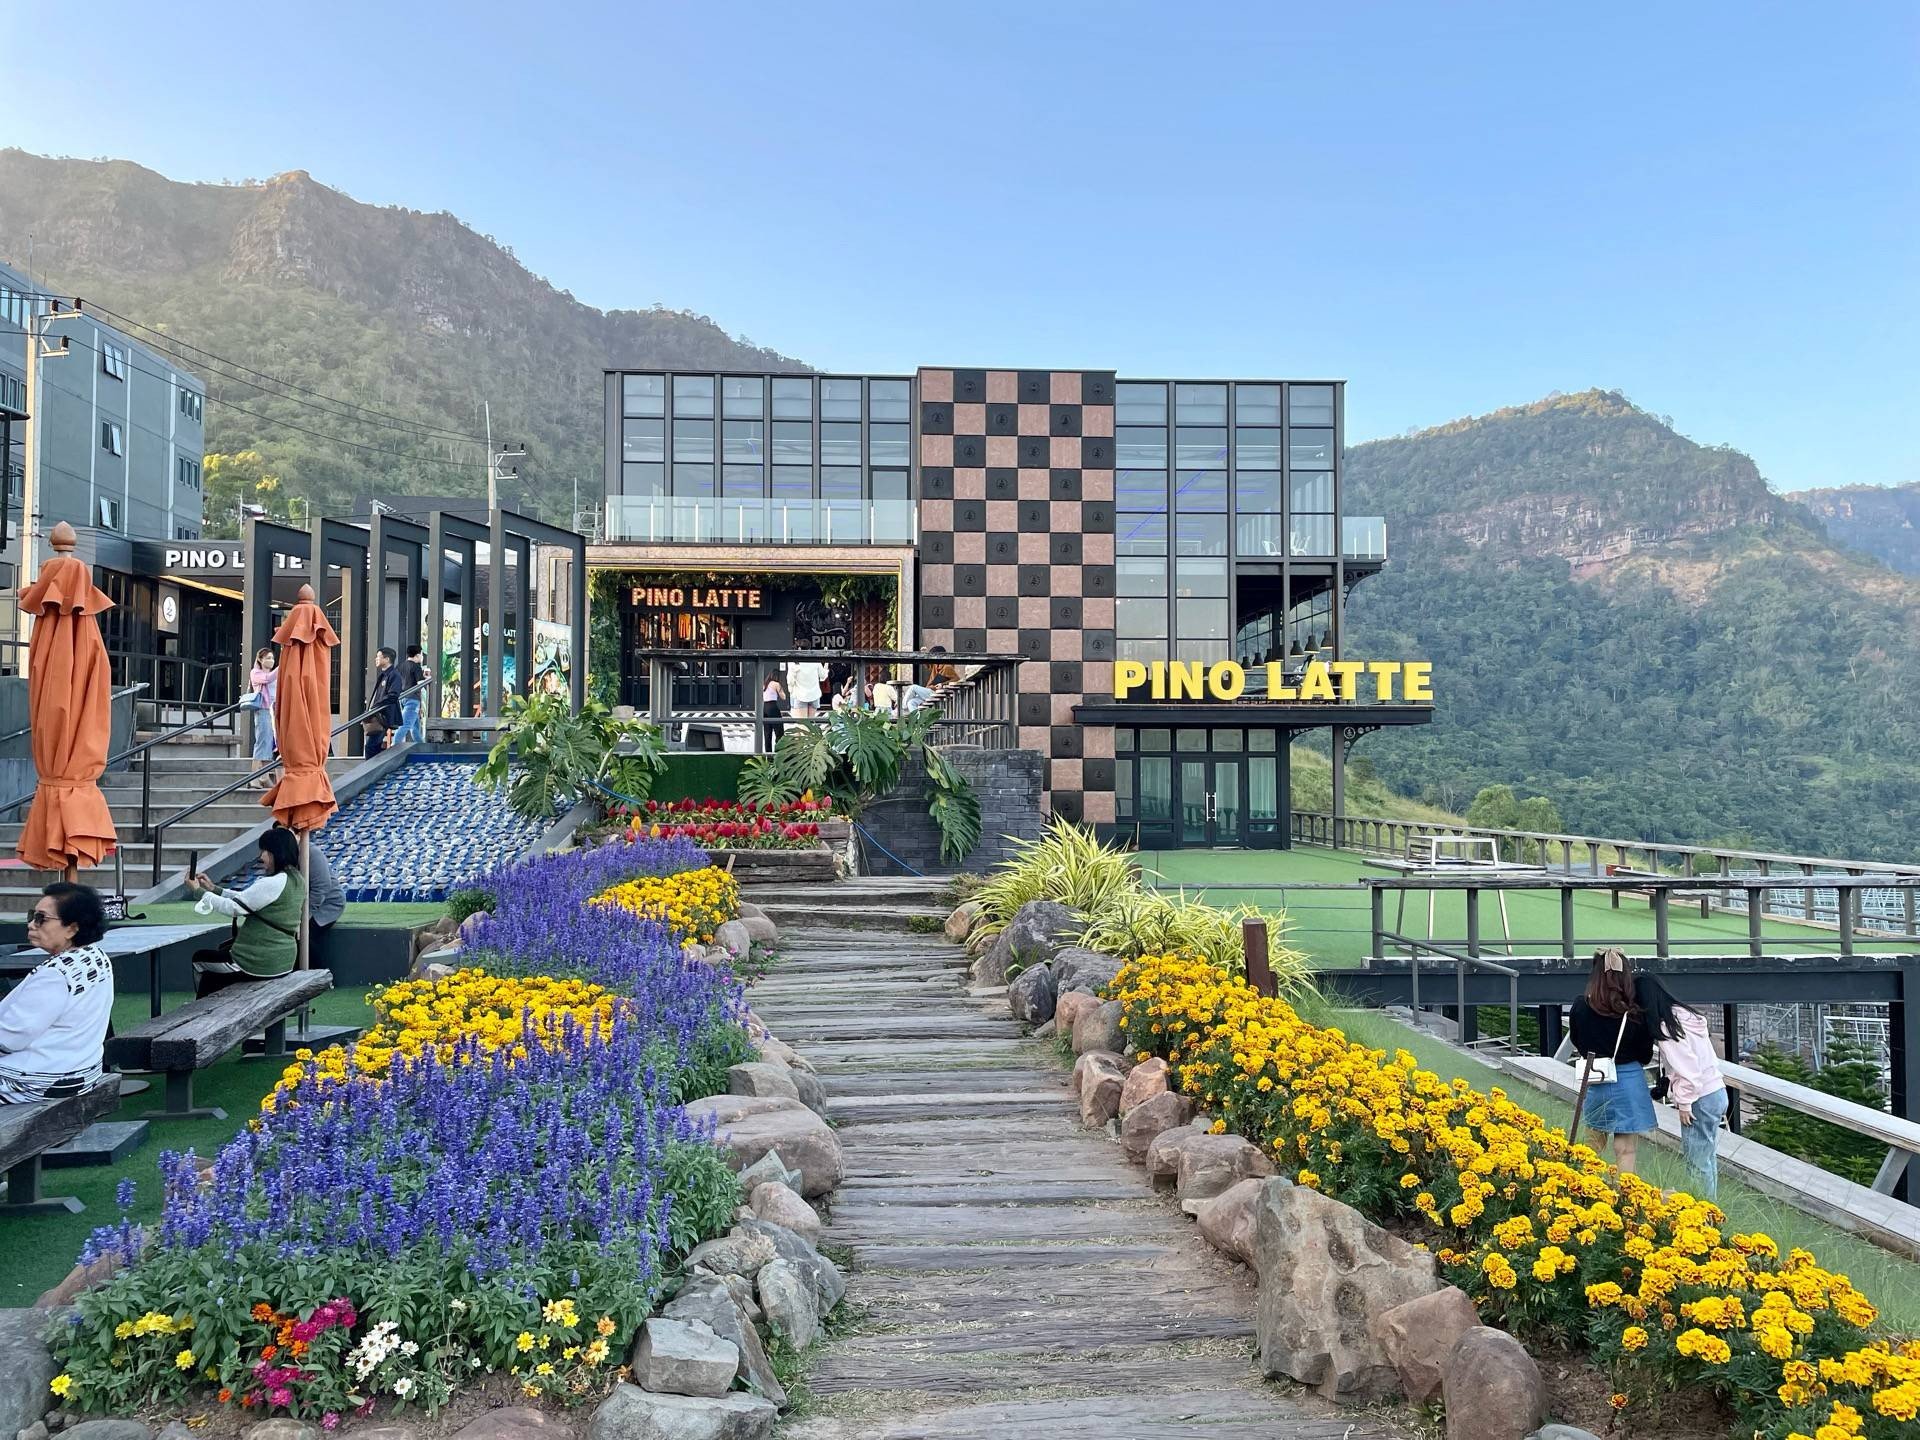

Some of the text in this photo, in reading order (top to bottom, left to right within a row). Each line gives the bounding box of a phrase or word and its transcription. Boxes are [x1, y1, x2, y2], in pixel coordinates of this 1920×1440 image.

[165, 550, 303, 569] PINO LTE
[631, 587, 761, 608] PINO LATTE
[811, 635, 846, 648] PINO
[1113, 660, 1434, 701] PINO LATTE
